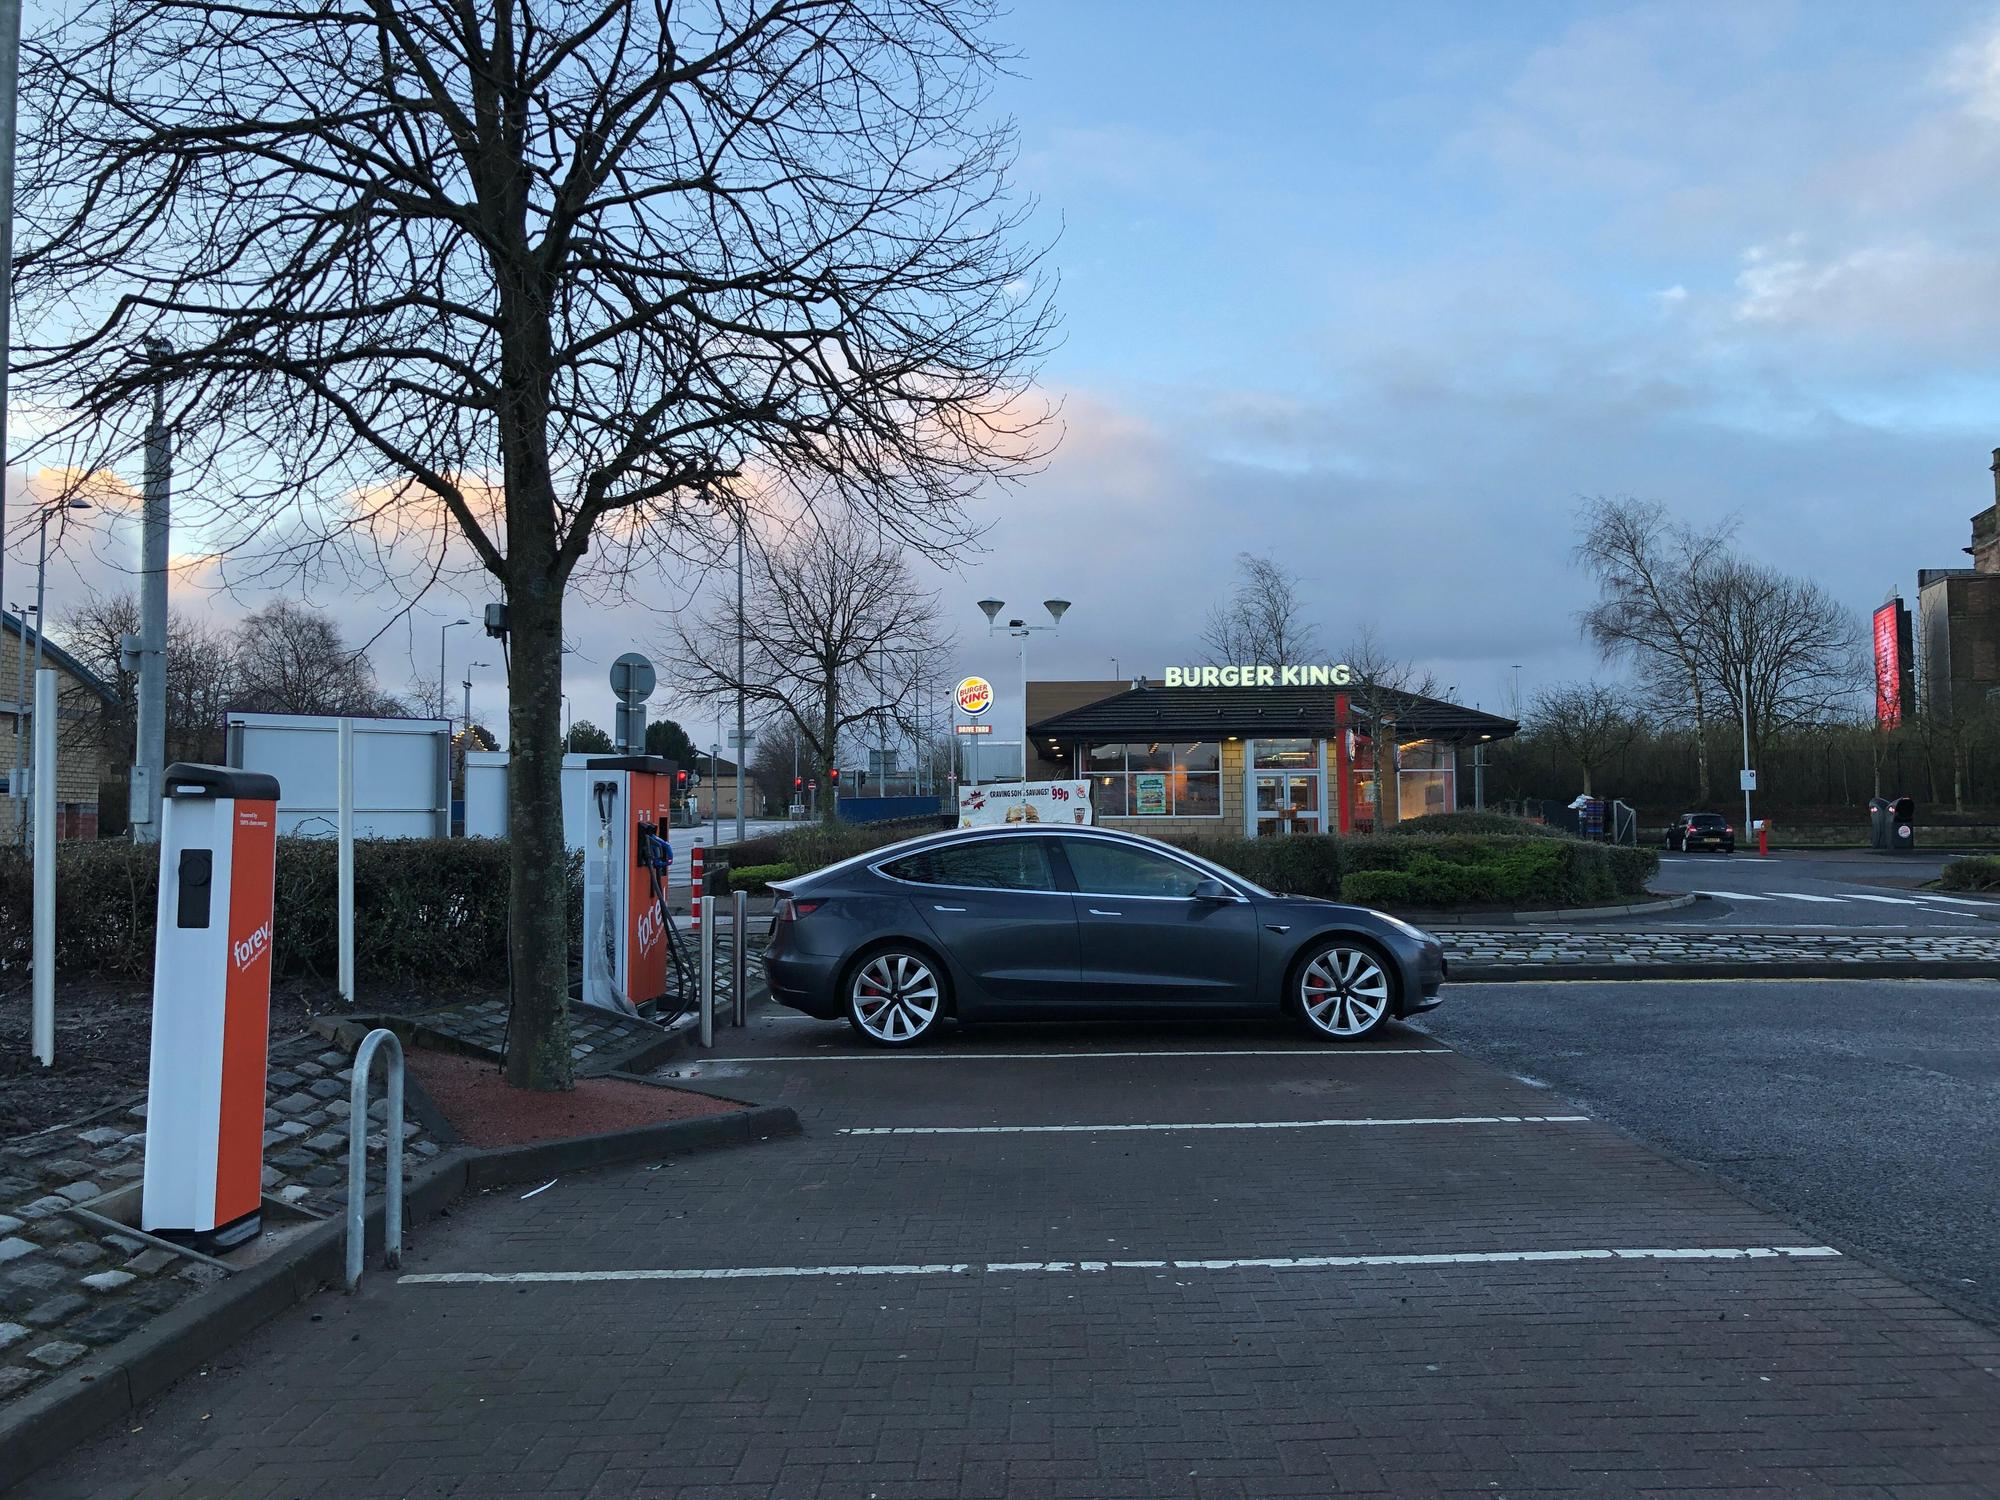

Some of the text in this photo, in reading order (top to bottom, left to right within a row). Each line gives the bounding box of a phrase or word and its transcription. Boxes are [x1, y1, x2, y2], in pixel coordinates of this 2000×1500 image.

[1164, 664, 1351, 687] BURGER KING
[960, 684, 988, 697] BURGER
[960, 691, 989, 705] KING
[990, 790, 1011, 798] CRAVING
[1051, 787, 1070, 801] 99p
